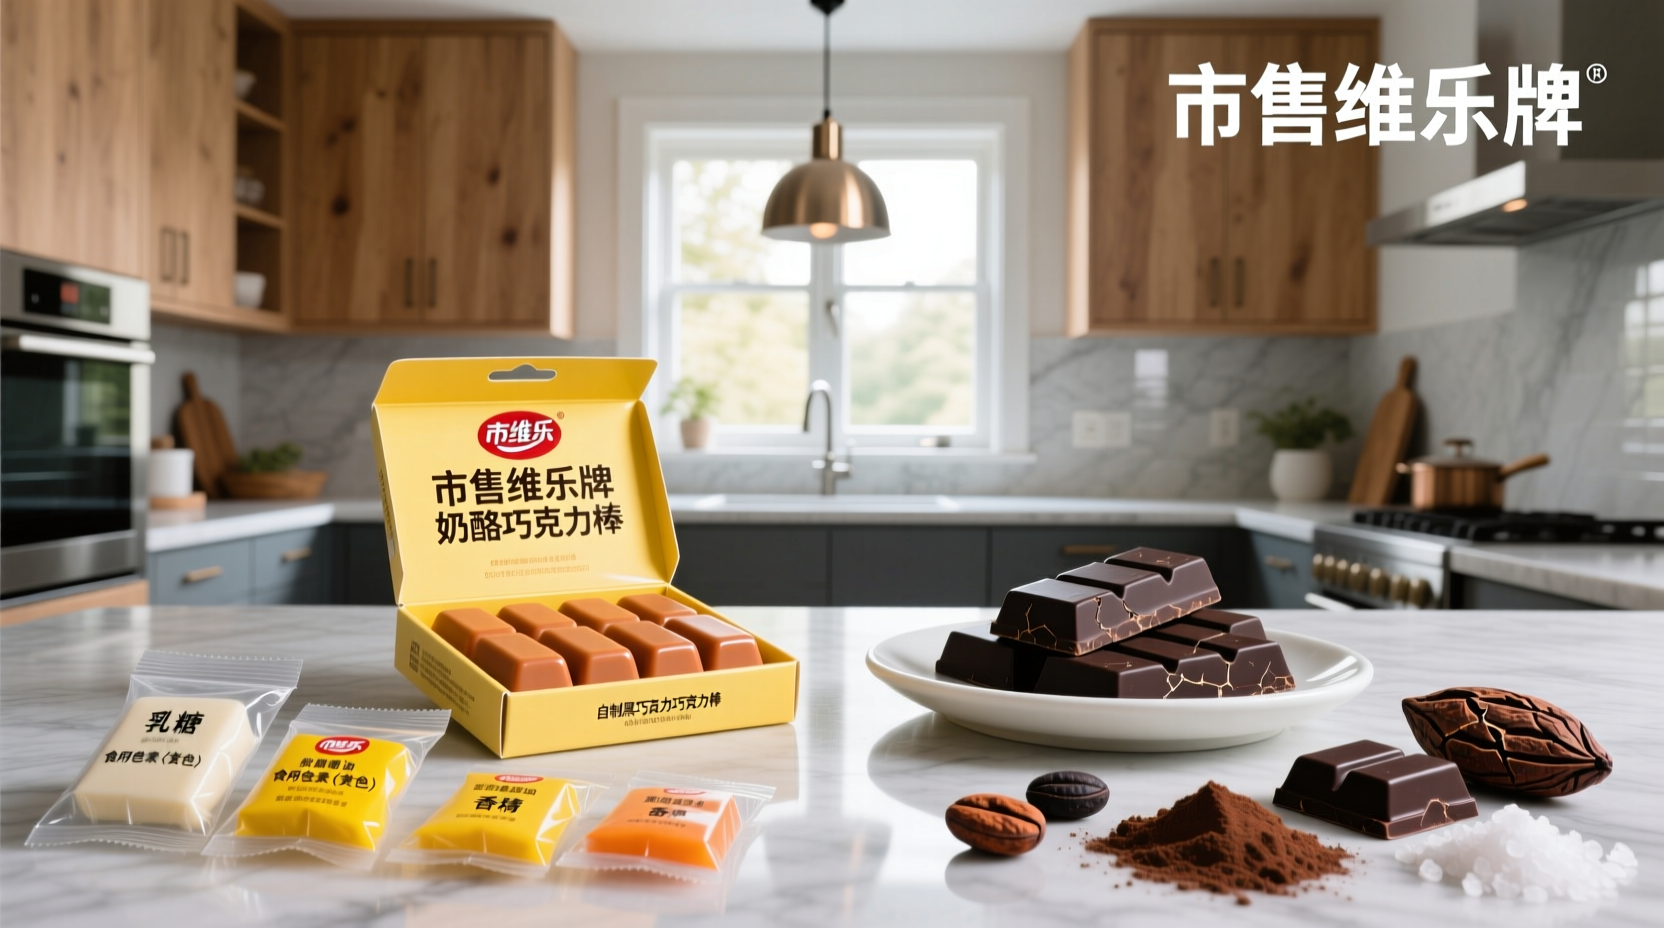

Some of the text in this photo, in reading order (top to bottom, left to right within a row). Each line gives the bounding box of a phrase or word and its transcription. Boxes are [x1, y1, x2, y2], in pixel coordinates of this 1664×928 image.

[485, 419, 554, 446] 市维乐
[432, 464, 614, 507] 市售维乐牌
[435, 502, 624, 545] 奶酪巧克力棒
[145, 709, 205, 735] 乳糖
